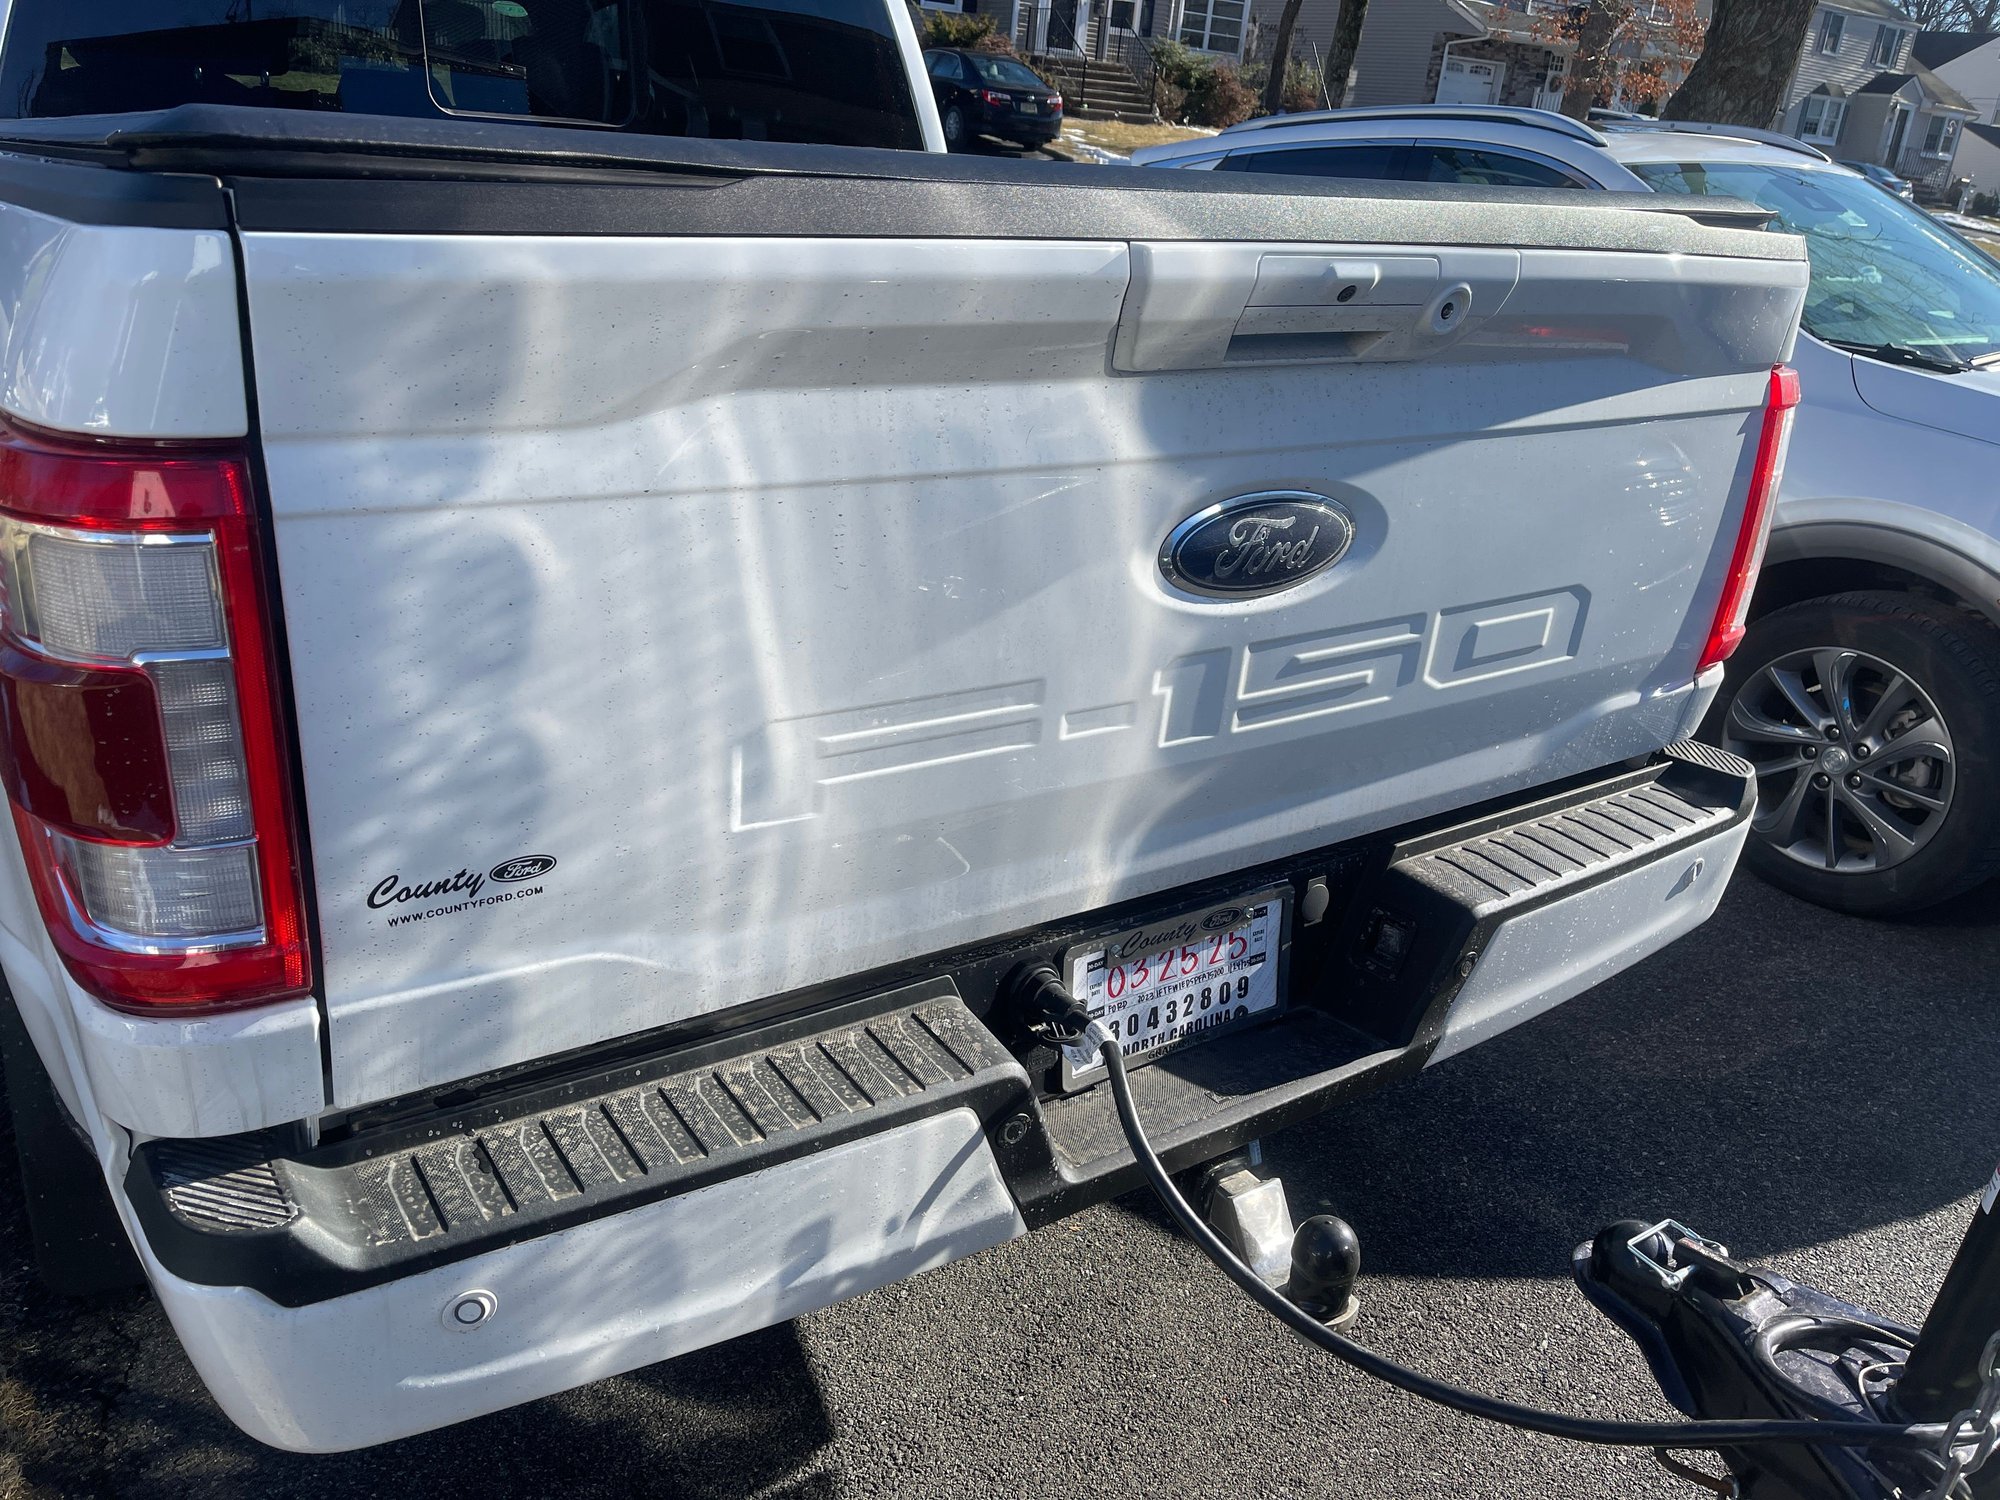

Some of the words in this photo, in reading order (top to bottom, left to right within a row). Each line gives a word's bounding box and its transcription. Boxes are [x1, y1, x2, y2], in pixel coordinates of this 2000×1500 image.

[1214, 515, 1320, 579] Ford
[730, 584, 1591, 832] F-150
[367, 869, 485, 909] County
[504, 860, 542, 879] Ford
[388, 886, 543, 927] WWW.COUNTYFORD.COM
[1121, 921, 1197, 958] County
[1108, 1000, 1128, 1014] FORD
[1122, 1031, 1165, 1057] NORTH
[1170, 1009, 1231, 1041] CAROLINA
